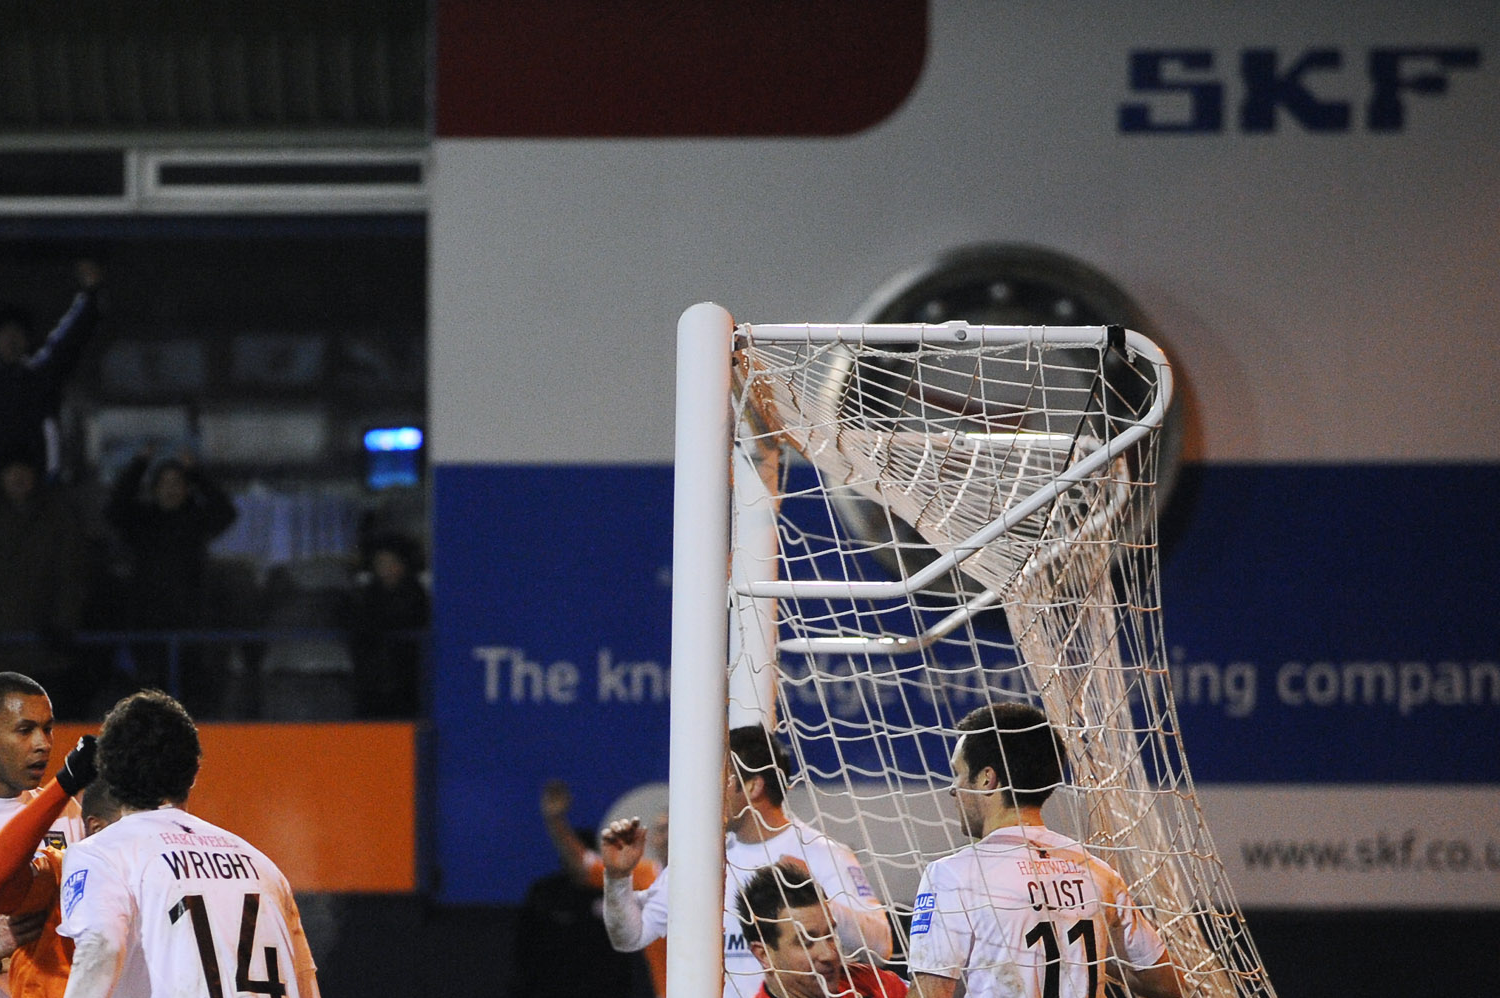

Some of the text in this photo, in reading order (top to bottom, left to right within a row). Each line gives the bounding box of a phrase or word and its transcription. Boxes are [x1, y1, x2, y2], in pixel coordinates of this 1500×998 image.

[1117, 48, 1482, 134] SKF
[475, 648, 578, 700] The
[161, 850, 260, 881] WRIGHT
[1027, 879, 1084, 911] CLIST
